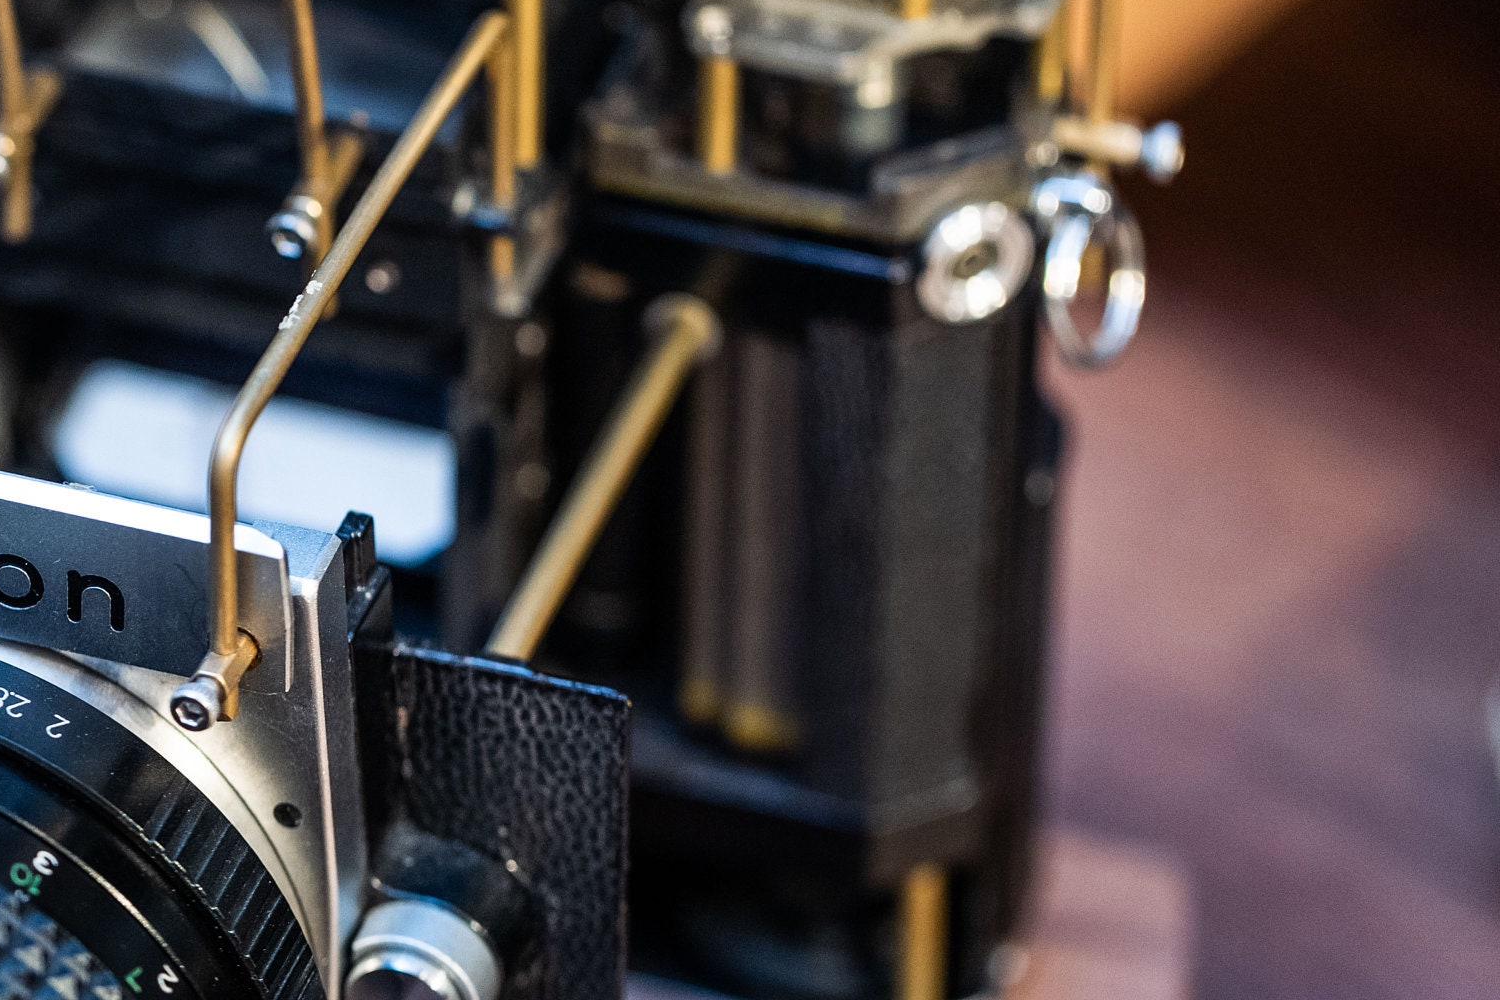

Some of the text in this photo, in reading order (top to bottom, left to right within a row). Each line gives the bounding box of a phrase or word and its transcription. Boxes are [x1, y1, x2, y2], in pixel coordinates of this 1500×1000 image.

[45, 713, 71, 739] 2
[32, 850, 59, 876] 3
[9, 862, 43, 896] 10
[156, 963, 180, 994] 2
